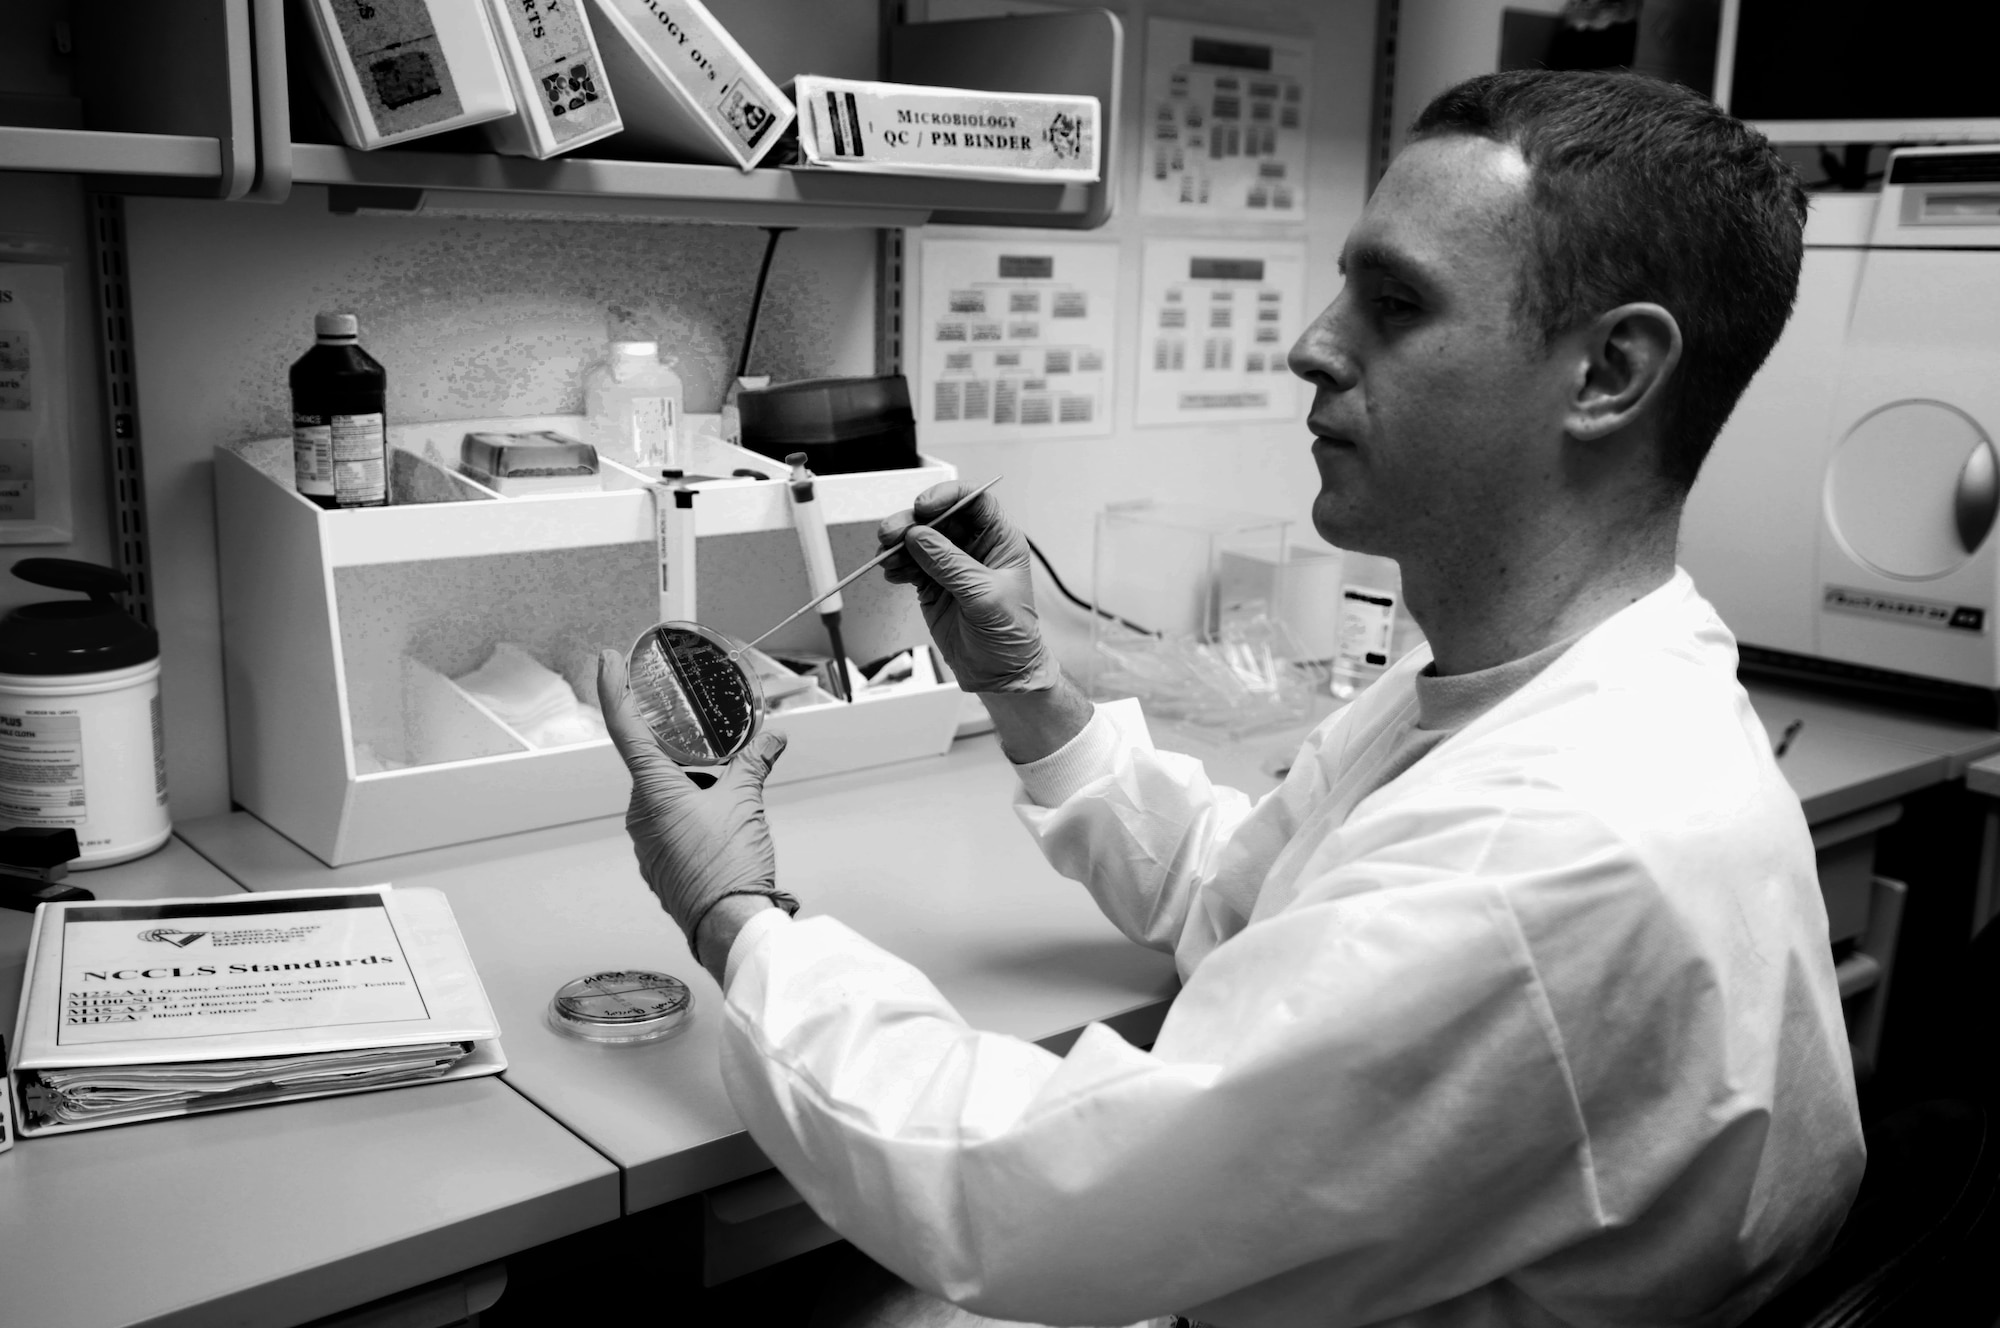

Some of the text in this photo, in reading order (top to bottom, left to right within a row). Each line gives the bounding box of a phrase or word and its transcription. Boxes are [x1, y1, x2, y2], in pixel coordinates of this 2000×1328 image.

[883, 129, 1032, 151] QC / PM BINDER
[14, 730, 36, 739] CLOTH
[82, 955, 393, 982] NCCLS Standards
[215, 983, 266, 991] Control
[299, 978, 339, 986] Media
